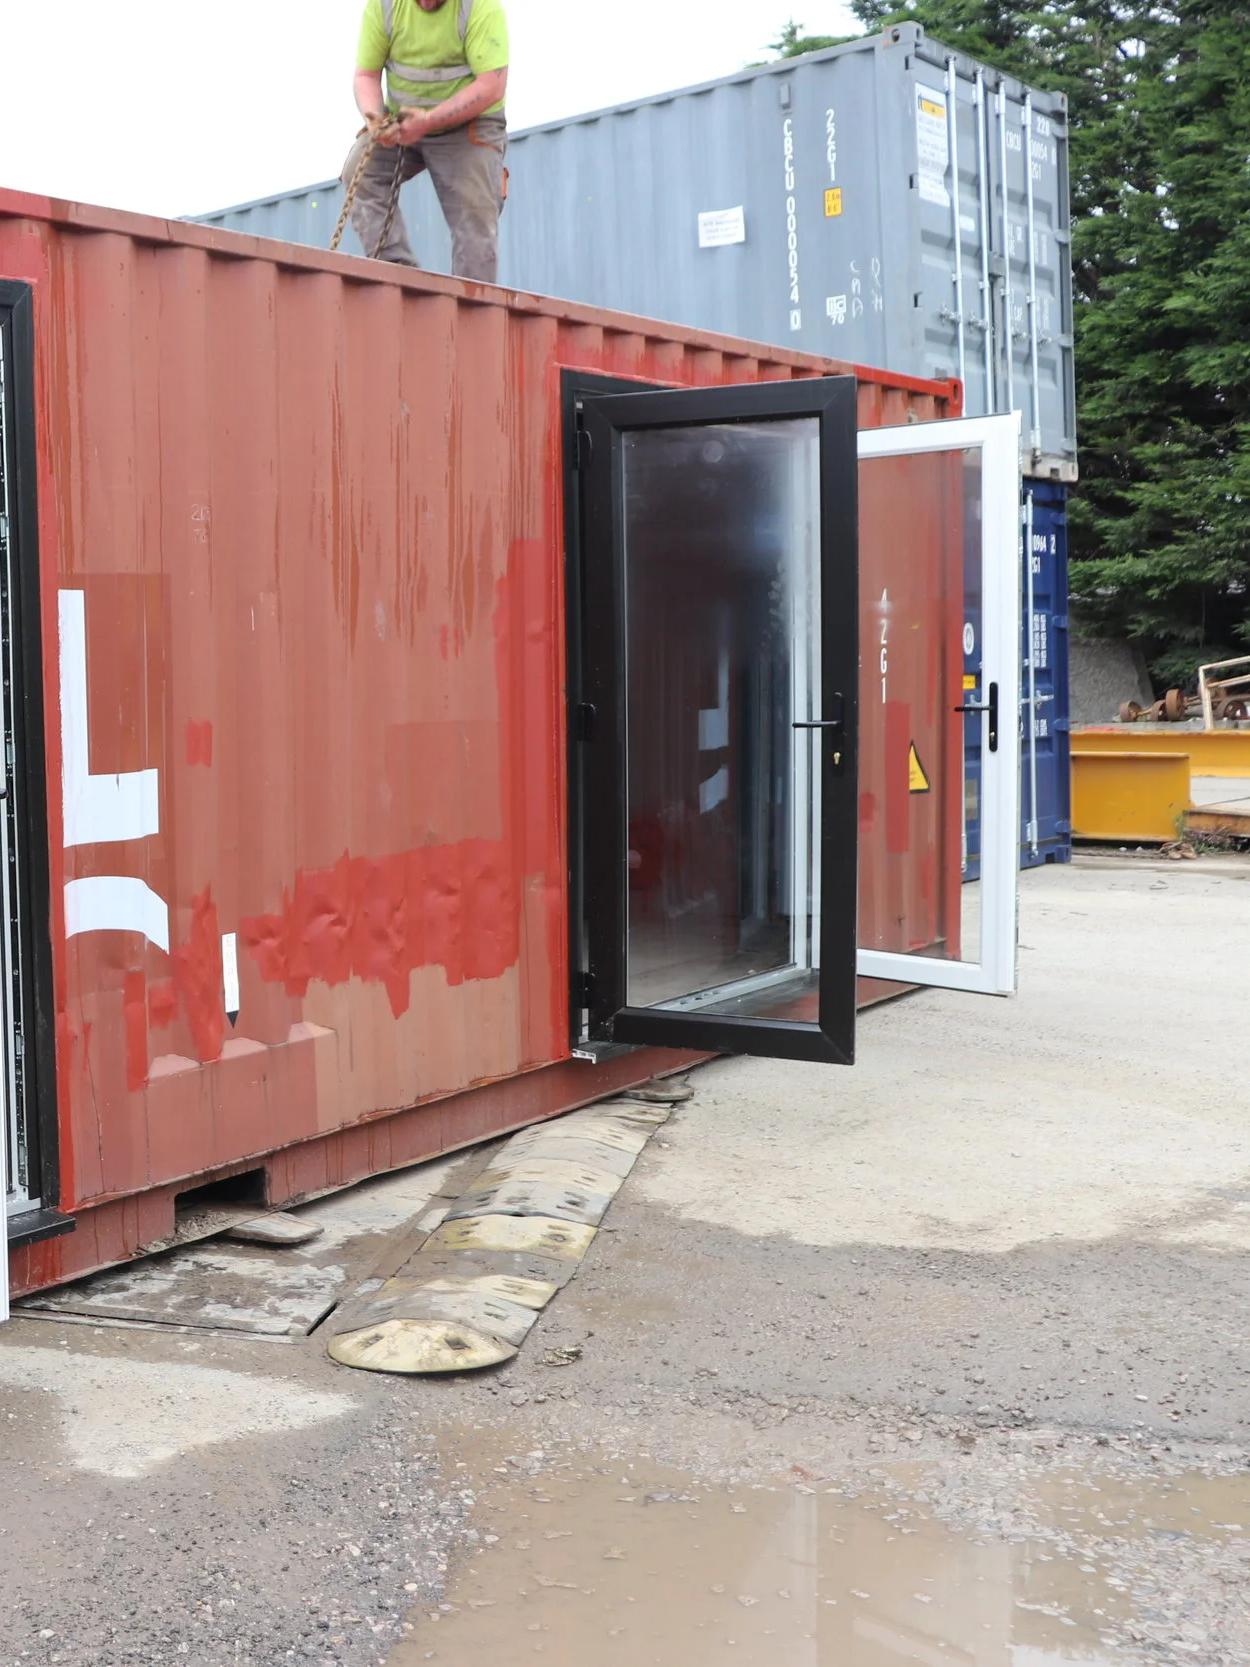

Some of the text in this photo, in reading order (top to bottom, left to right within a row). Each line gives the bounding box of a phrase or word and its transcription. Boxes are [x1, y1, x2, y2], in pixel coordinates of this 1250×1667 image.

[825, 108, 837, 181] 22G1
[783, 118, 802, 330] CBCU 000054 0
[880, 587, 888, 704] 42G1
